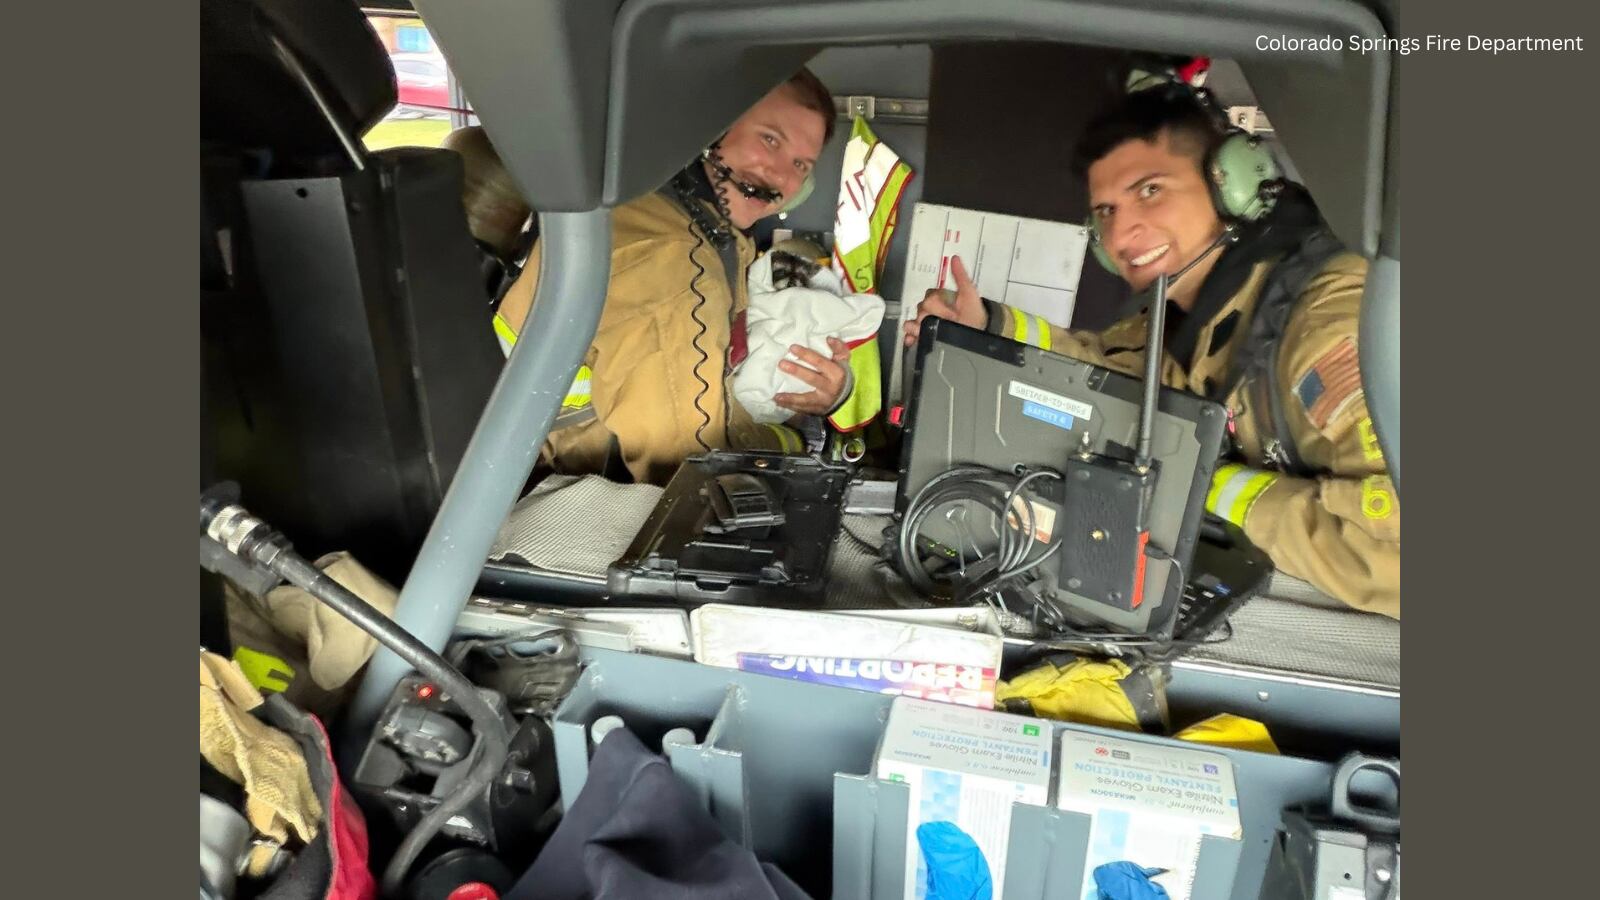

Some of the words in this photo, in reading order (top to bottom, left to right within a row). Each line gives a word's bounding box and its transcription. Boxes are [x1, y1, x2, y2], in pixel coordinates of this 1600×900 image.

[1361, 475, 1392, 520] 6
[912, 729, 978, 747] PROTECTION
[929, 741, 970, 755] Gloves
[972, 749, 1001, 761] Exam
[982, 741, 1039, 756] FENTANYL
[1004, 752, 1039, 766] Nitrile
[1074, 761, 1152, 783] PROTECTION
[1096, 776, 1144, 792] Gloves
[1158, 776, 1222, 793] FENTANYL
[1147, 785, 1182, 799] Exam
[1184, 790, 1224, 805] Nitrile
